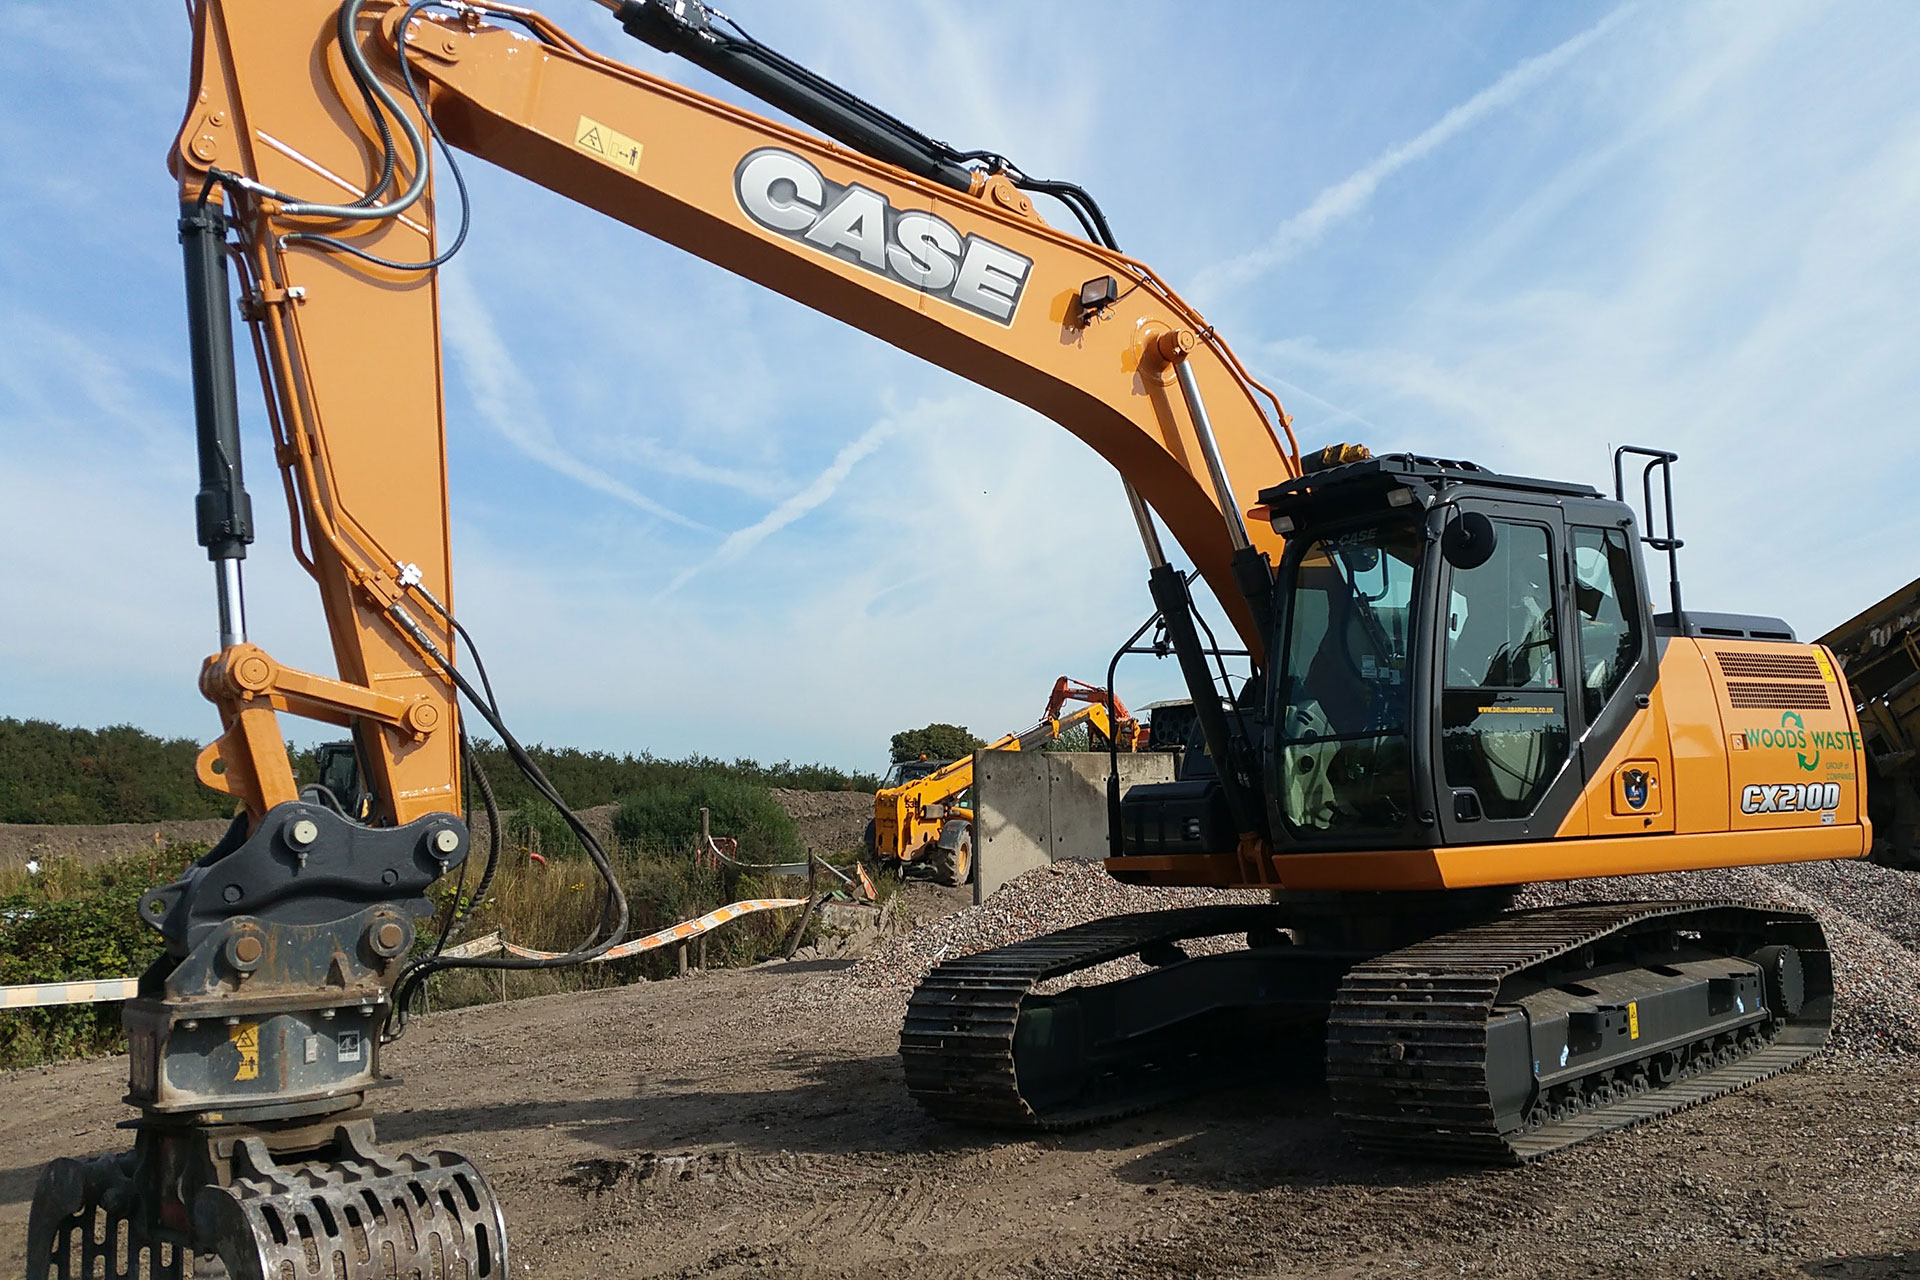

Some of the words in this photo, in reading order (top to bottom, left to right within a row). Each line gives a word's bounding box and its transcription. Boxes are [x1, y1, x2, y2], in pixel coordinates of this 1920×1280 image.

[737, 150, 1031, 324] CASE
[1338, 527, 1378, 546] CASE
[1744, 728, 1807, 749] WOODS
[1811, 730, 1862, 750] WASTE
[1741, 782, 1841, 814] CX210D
